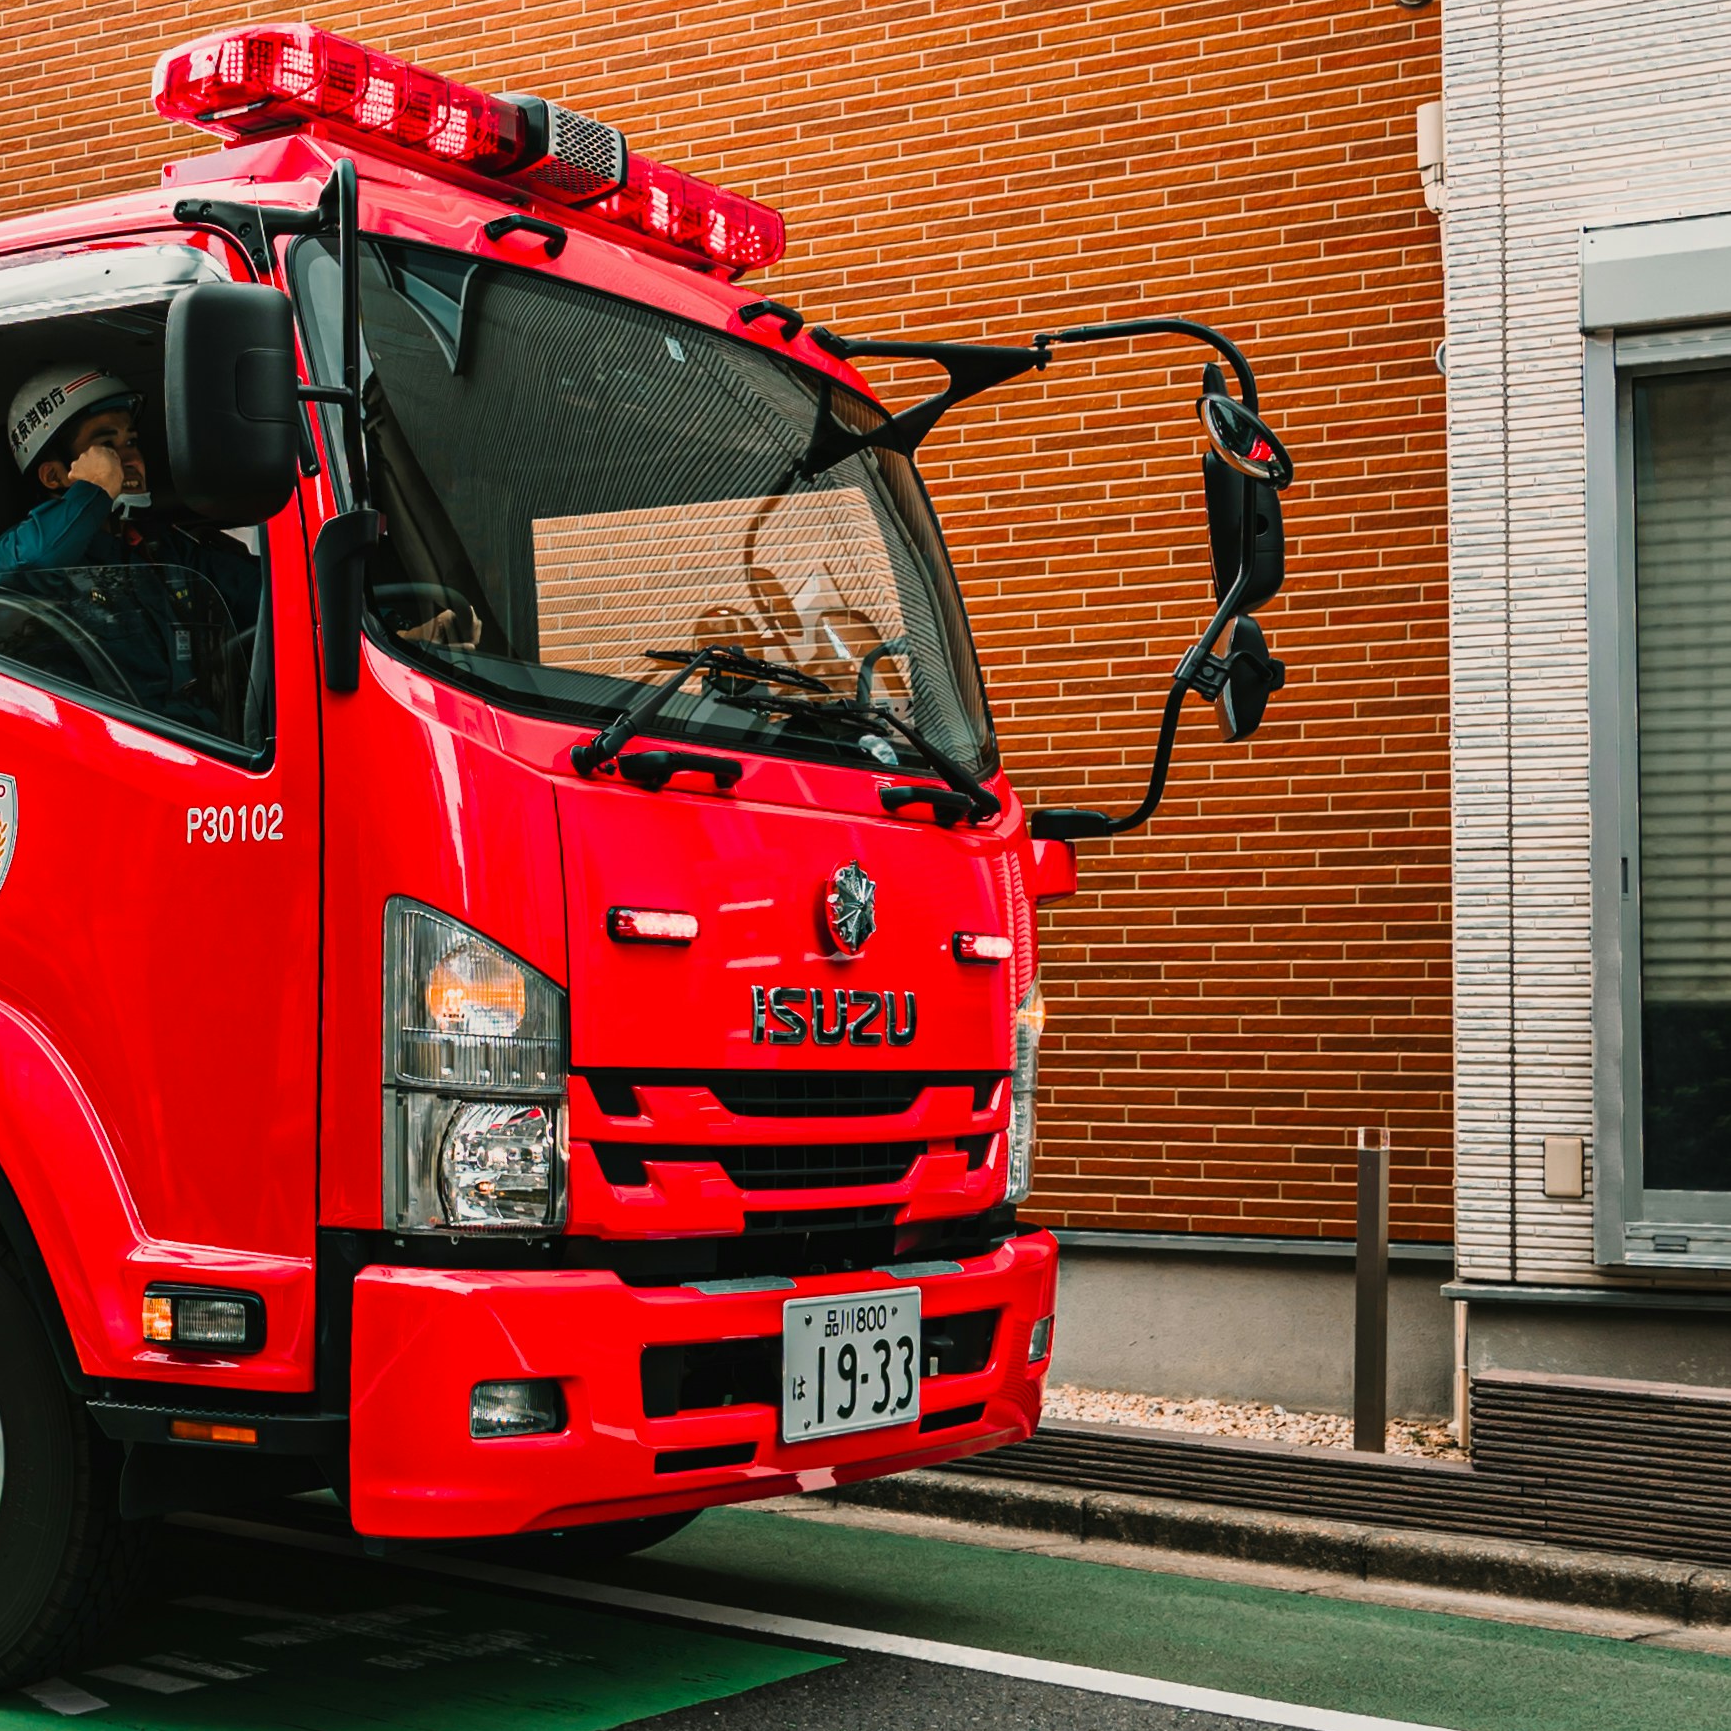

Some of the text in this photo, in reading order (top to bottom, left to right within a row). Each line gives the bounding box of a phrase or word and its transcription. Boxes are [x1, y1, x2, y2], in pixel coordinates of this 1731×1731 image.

[186, 802, 284, 844] P30102
[751, 984, 918, 1046] ISUZU
[792, 1335, 914, 1424] は 19-33
